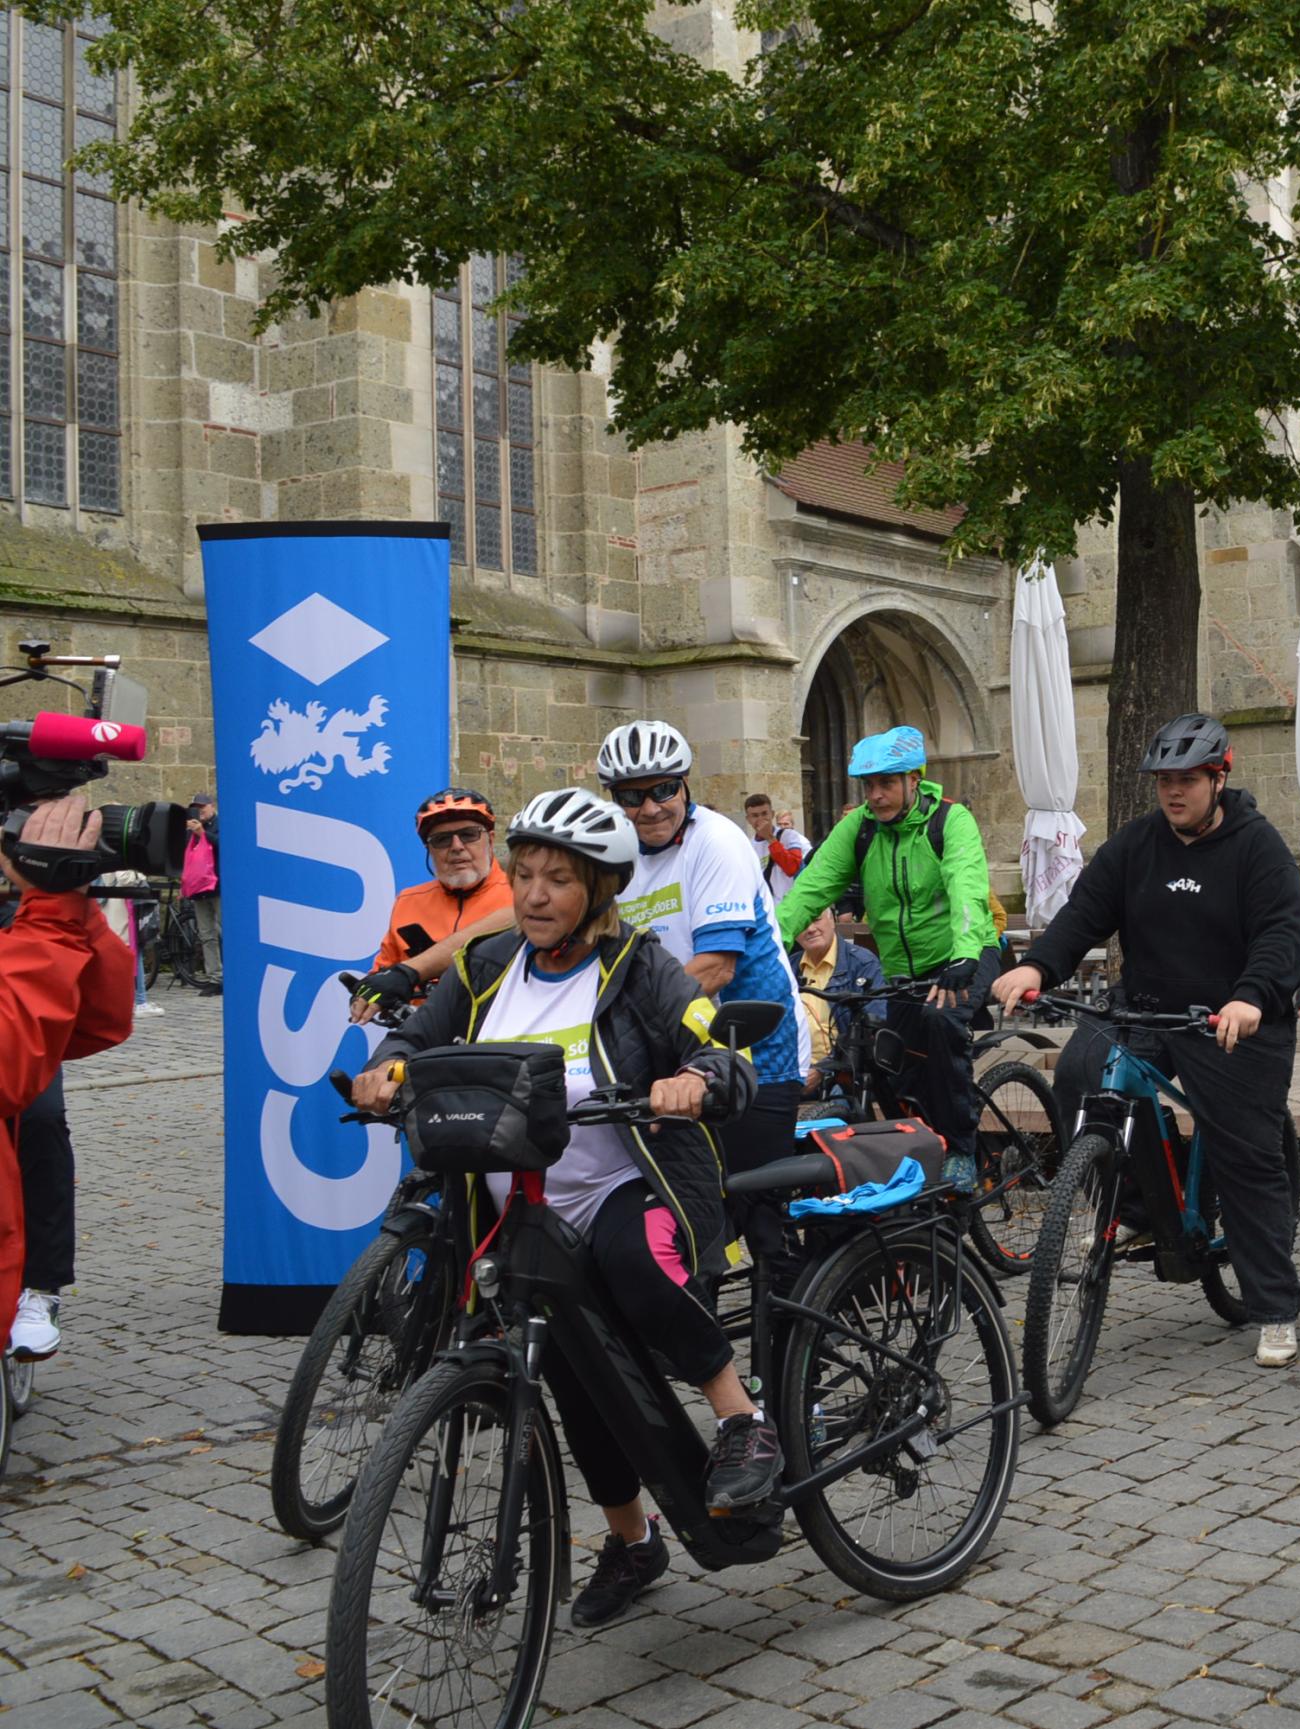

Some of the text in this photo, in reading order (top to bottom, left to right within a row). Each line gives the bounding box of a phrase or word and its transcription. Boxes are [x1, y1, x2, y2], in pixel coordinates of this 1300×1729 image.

[705, 902, 734, 916] CSU
[256, 801, 402, 1231] CSU
[445, 1113, 486, 1121] VAUDE
